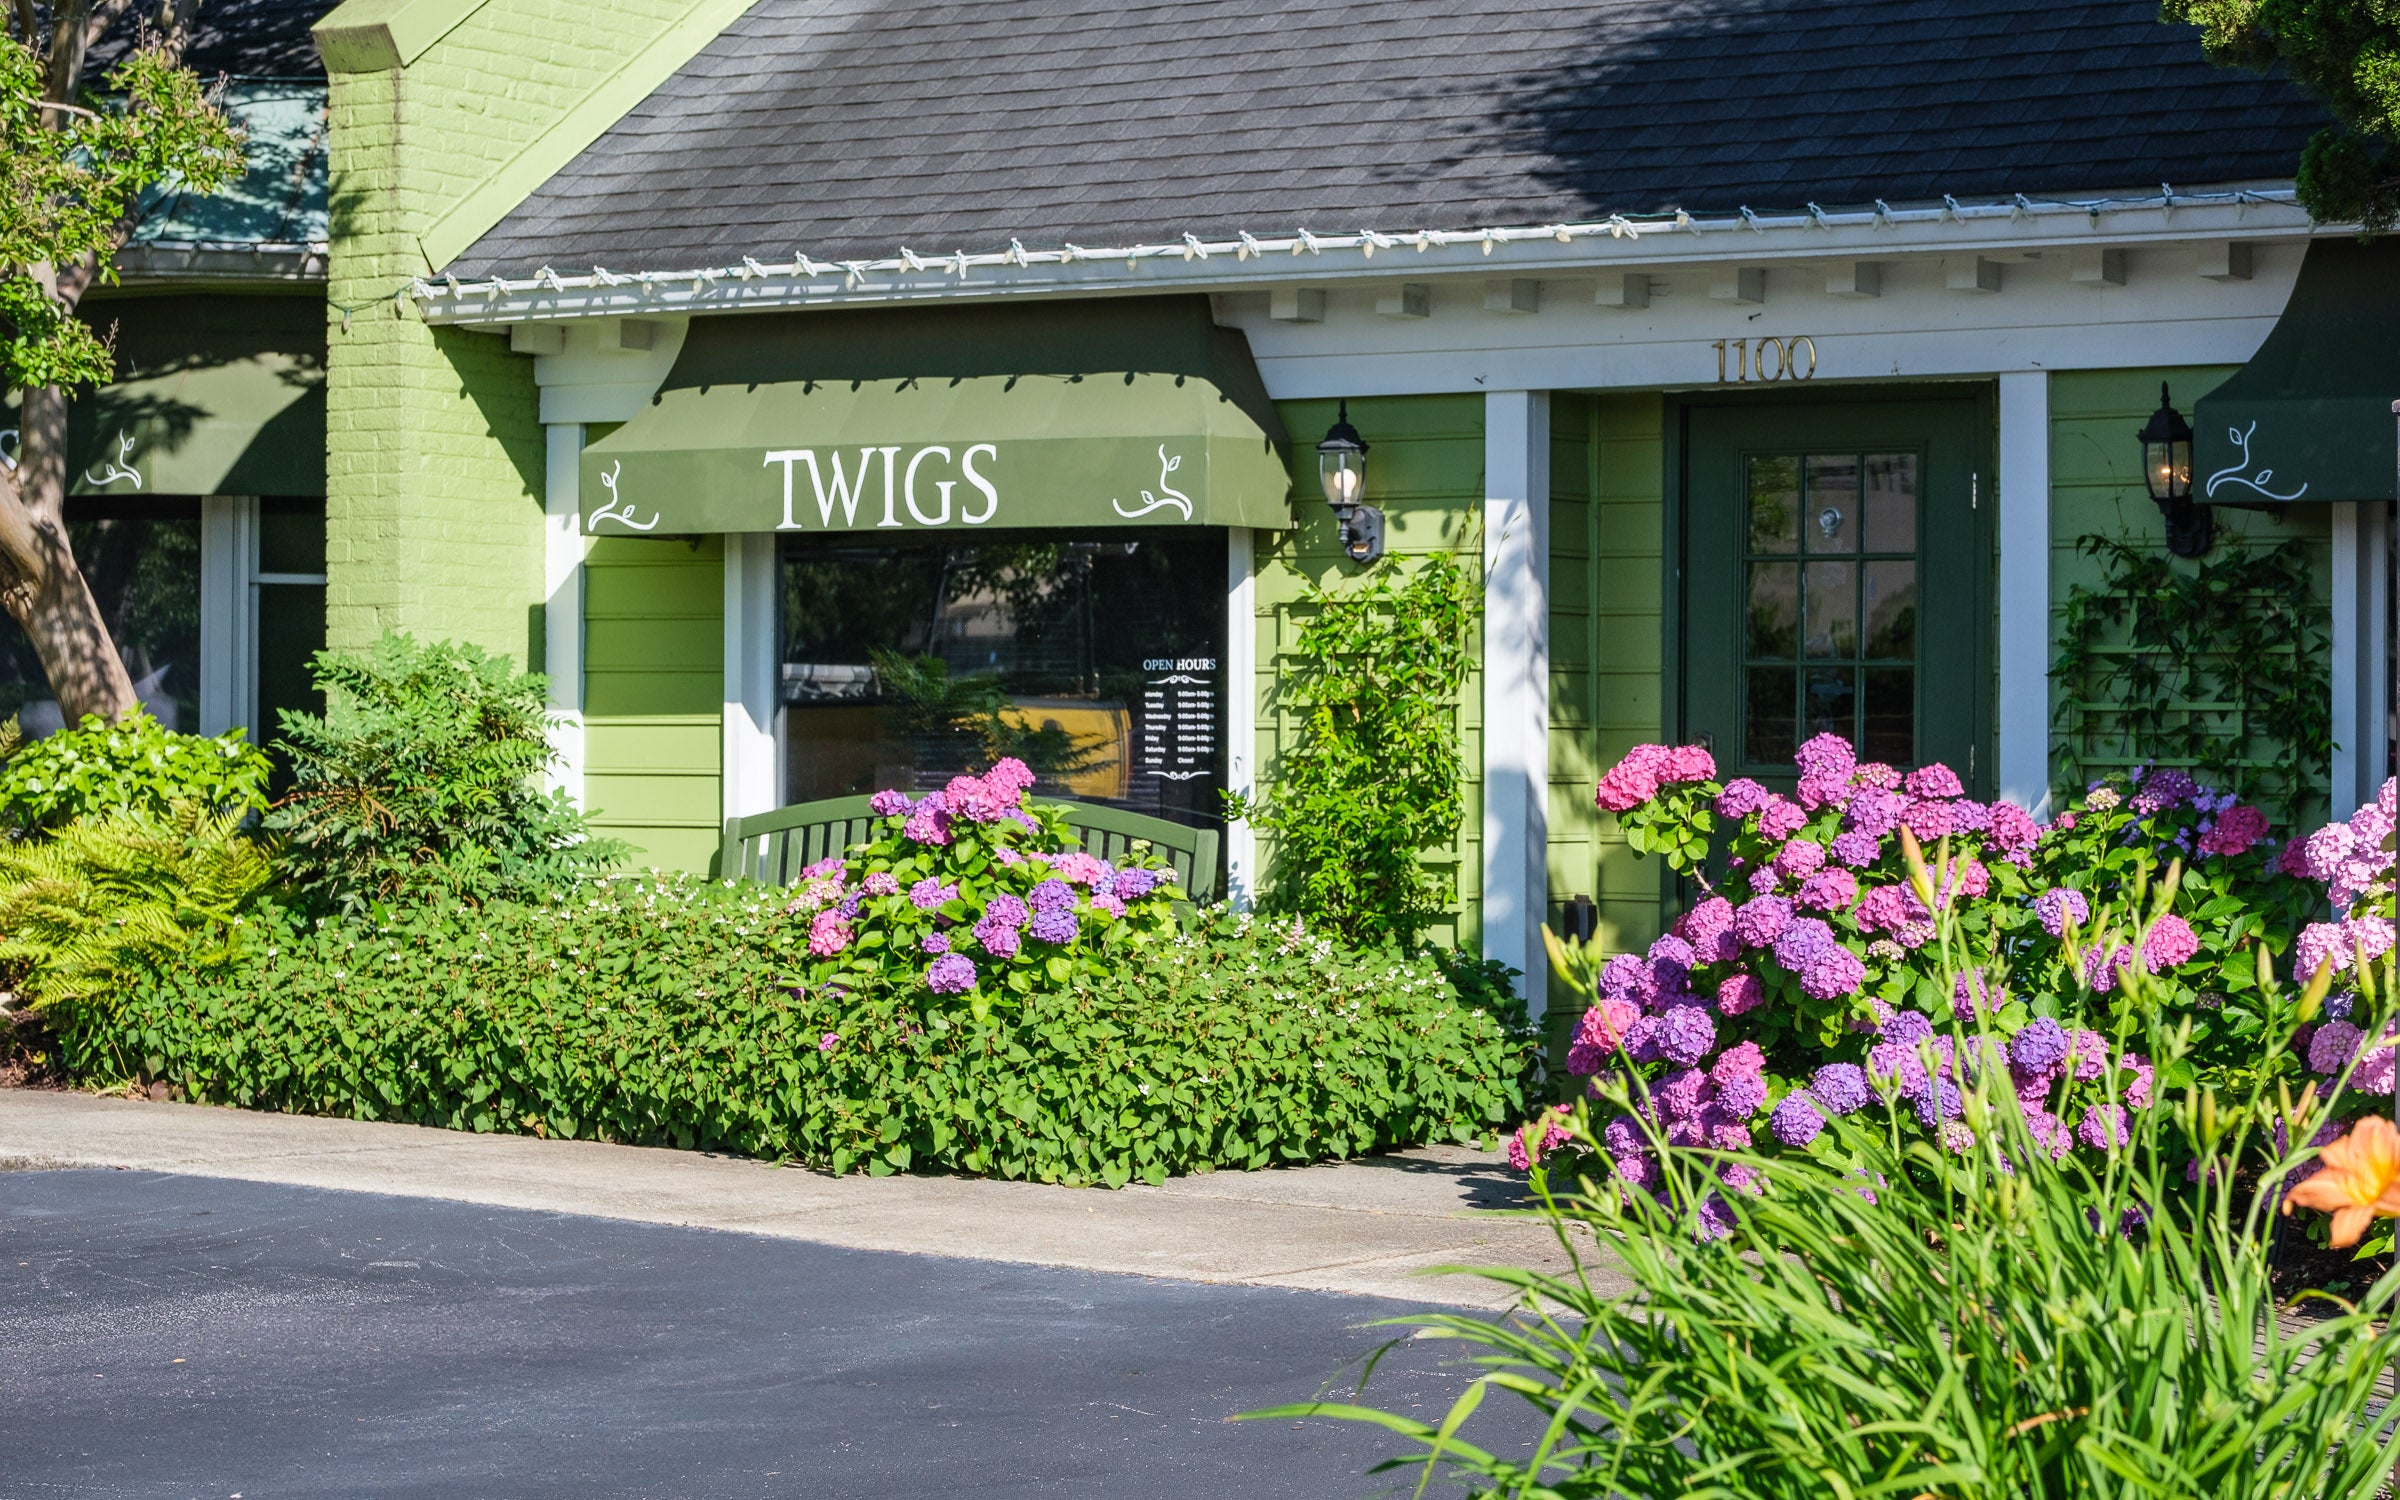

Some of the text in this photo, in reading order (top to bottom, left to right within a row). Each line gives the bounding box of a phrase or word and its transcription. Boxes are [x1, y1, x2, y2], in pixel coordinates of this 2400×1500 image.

[1711, 335, 1816, 386] 1100
[763, 443, 998, 529] TWIGS
[1143, 658, 1216, 670] OPEN HOURS
[1145, 735, 1159, 743] Friday
